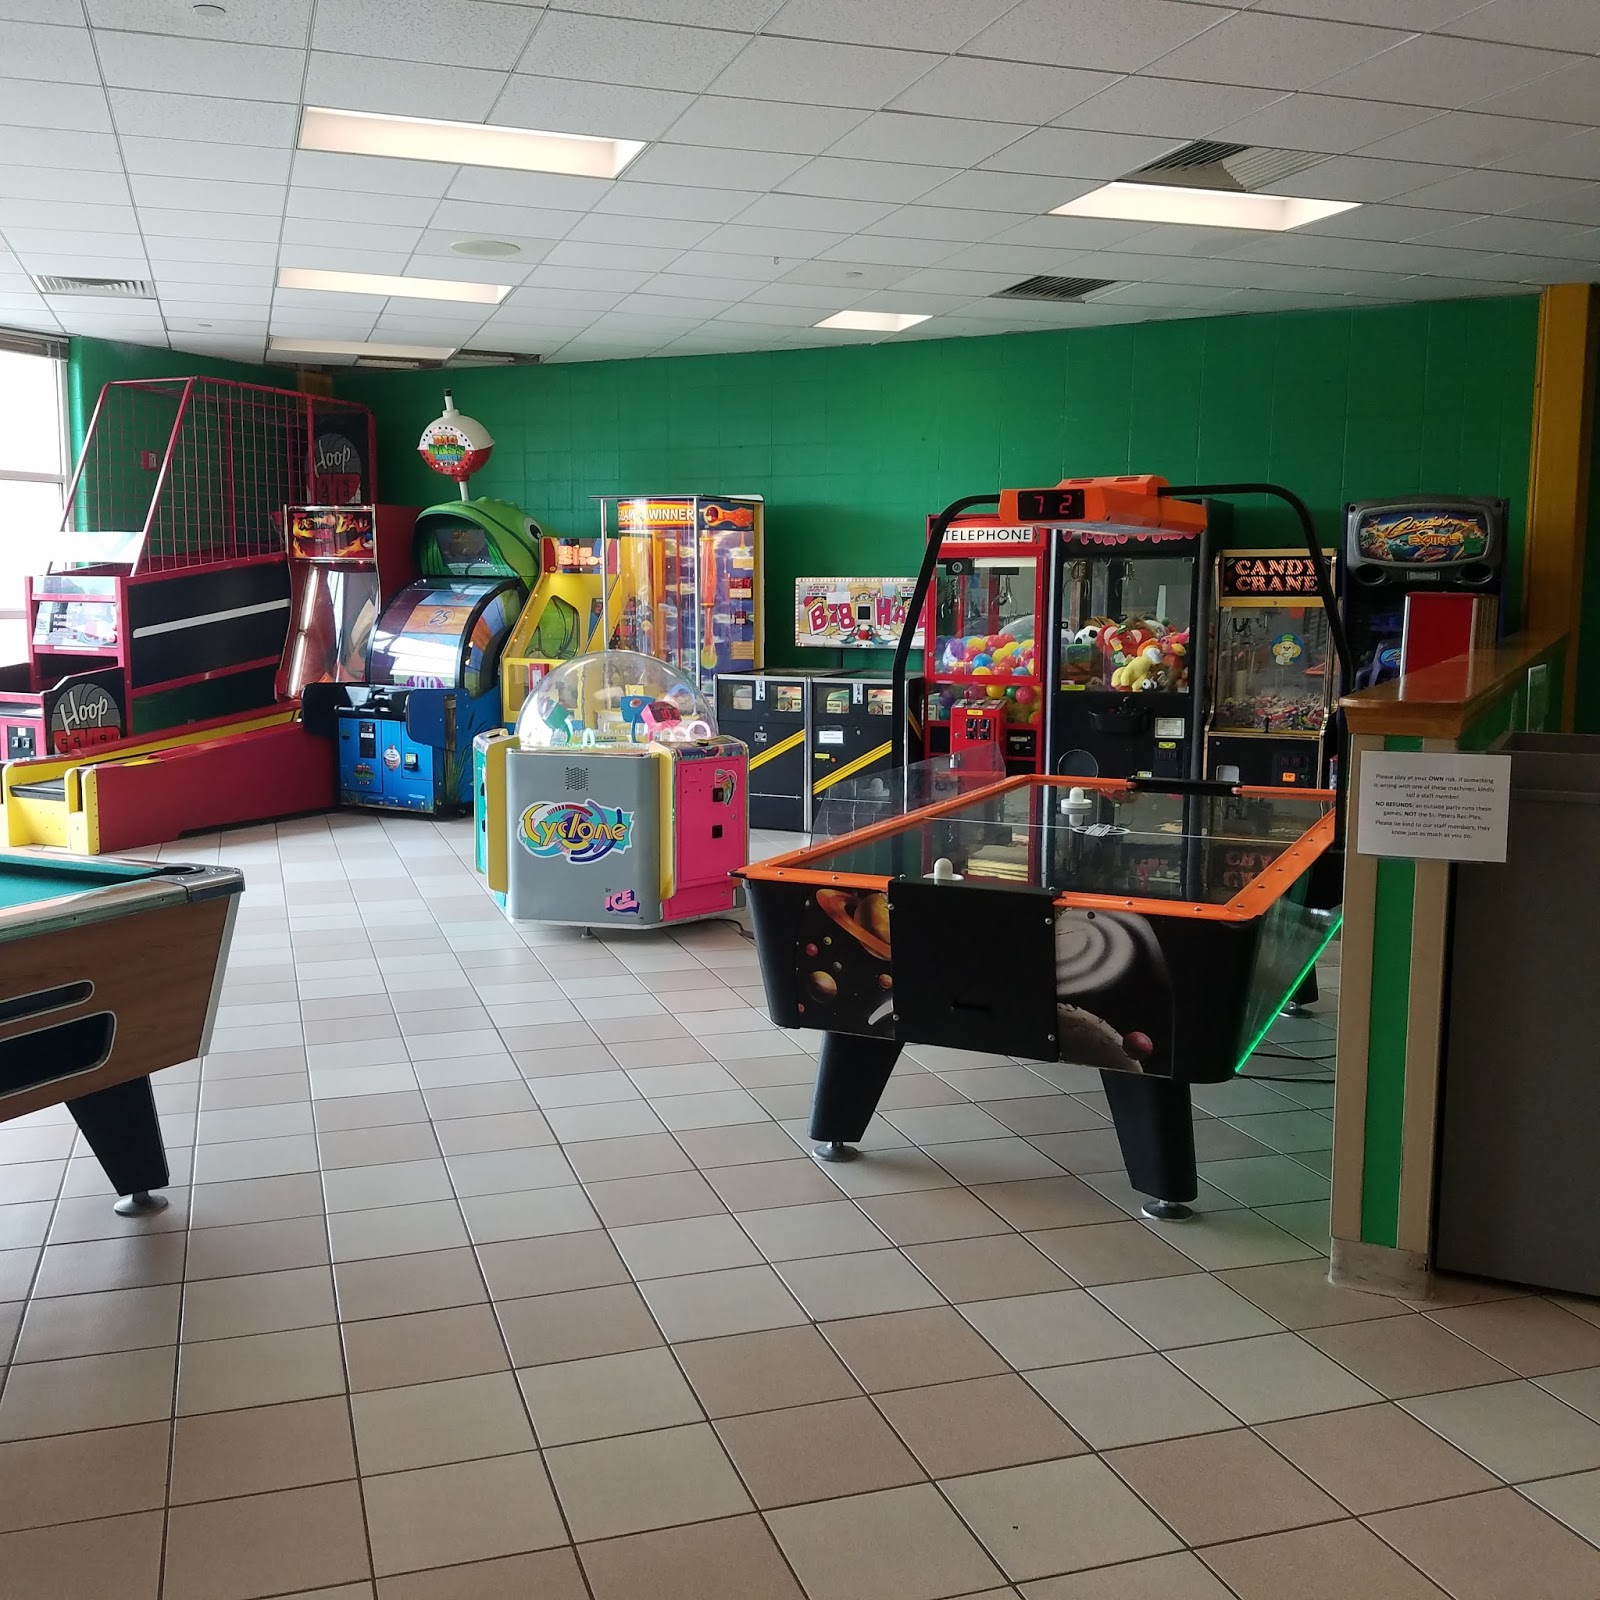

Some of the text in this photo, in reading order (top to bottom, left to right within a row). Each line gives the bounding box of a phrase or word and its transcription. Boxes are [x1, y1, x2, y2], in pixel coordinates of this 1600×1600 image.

[1033, 494, 1073, 515] 7 2
[943, 528, 1032, 542] TELEPHONE
[558, 544, 592, 557] Big
[1235, 576, 1318, 592] CRANE
[429, 609, 452, 625] 25
[60, 690, 108, 736] Hoop
[521, 803, 627, 847] Cyclone
[604, 888, 641, 915] ICE
